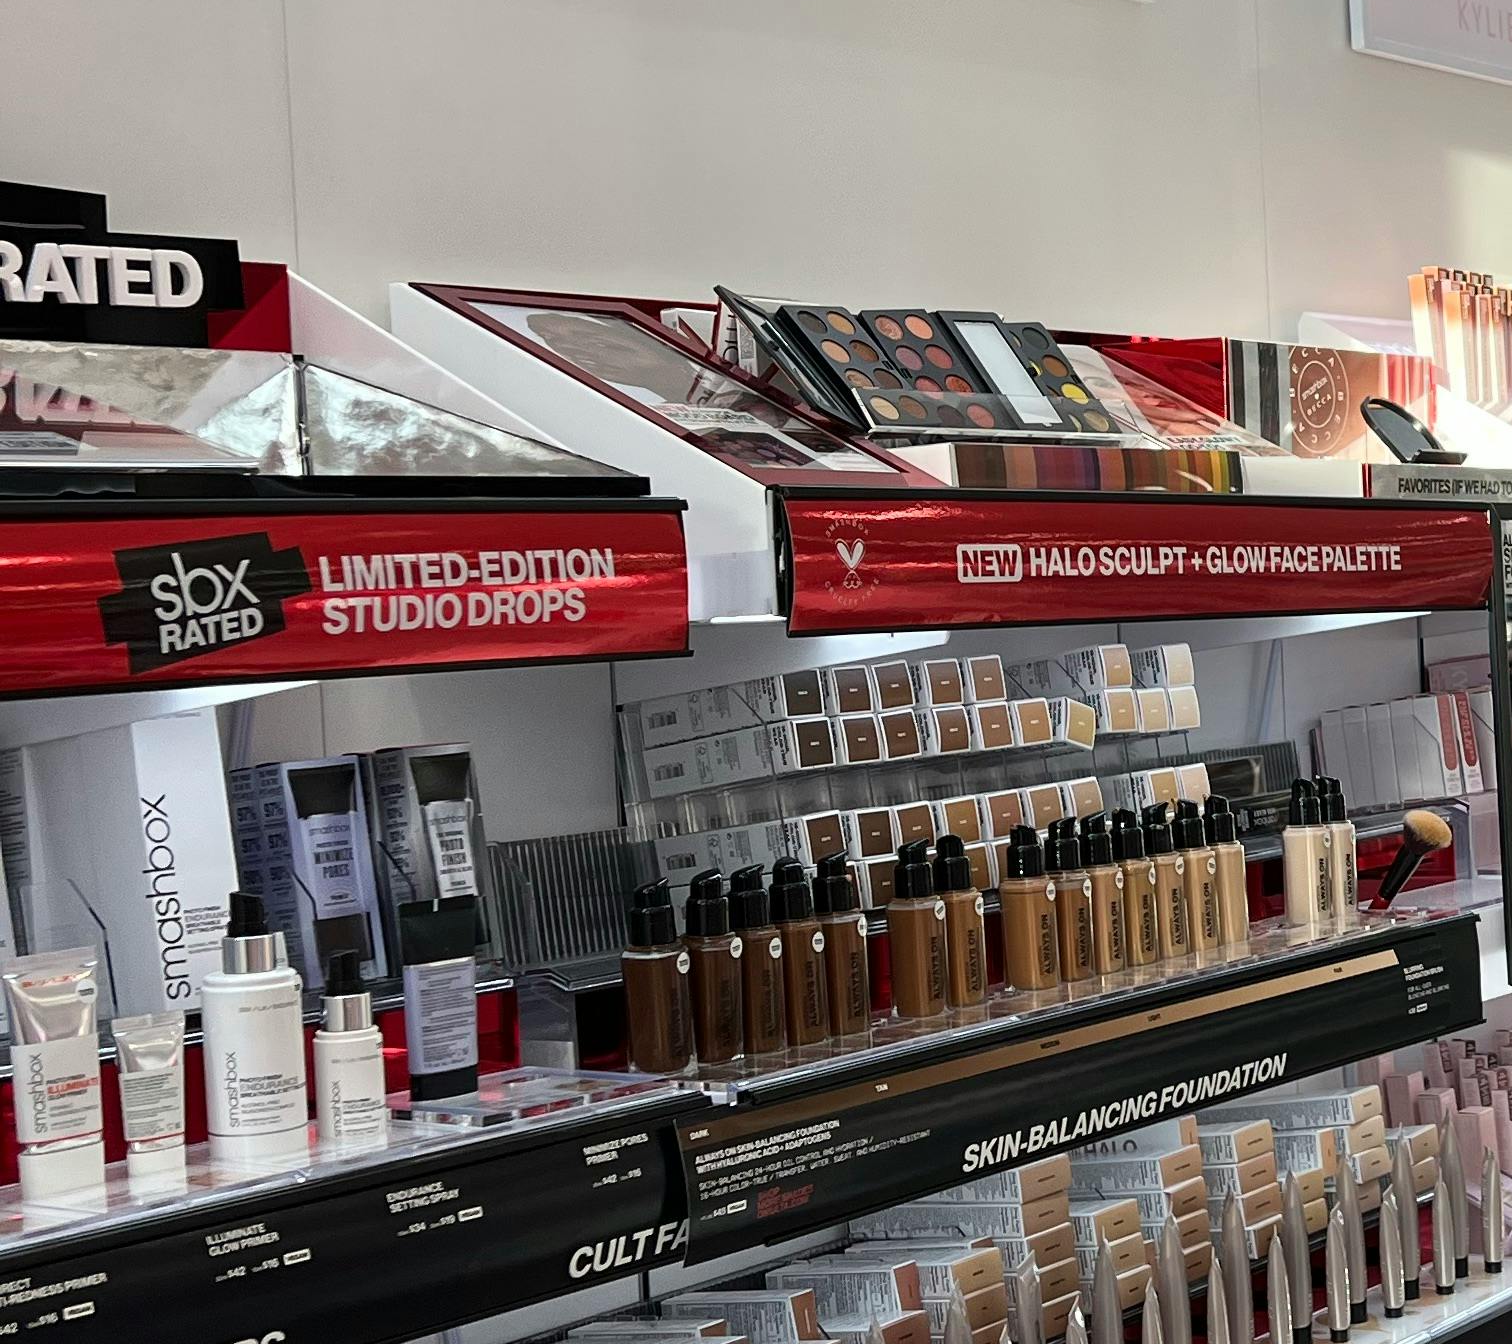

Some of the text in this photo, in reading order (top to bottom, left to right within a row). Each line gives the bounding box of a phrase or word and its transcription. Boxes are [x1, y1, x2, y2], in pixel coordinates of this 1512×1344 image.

[1398, 477, 1450, 494] FAVORITES
[1464, 479, 1480, 494] WE
[1480, 479, 1500, 494] HAD
[1501, 481, 1512, 494] TO
[320, 548, 616, 593] LIMITED-EDITION
[962, 545, 1402, 578] NEW HALO SCULPT + GLOW FACE PALETTE
[152, 552, 258, 620] sbx
[160, 608, 263, 655] RATED
[322, 588, 586, 636] STUDIO DROPS
[141, 794, 191, 1000] smashbox
[1318, 875, 1328, 912] ALWAYS
[1173, 905, 1183, 945] ALWAYS
[1042, 935, 1052, 975] ALWAYS
[224, 1052, 241, 1128] smashbox
[962, 1053, 1288, 1172] SKIN-BALANCING FOUNDATION
[695, 1148, 725, 1165] ALWAYS
[208, 1240, 240, 1257] GLOW
[569, 1228, 655, 1279] CULT
